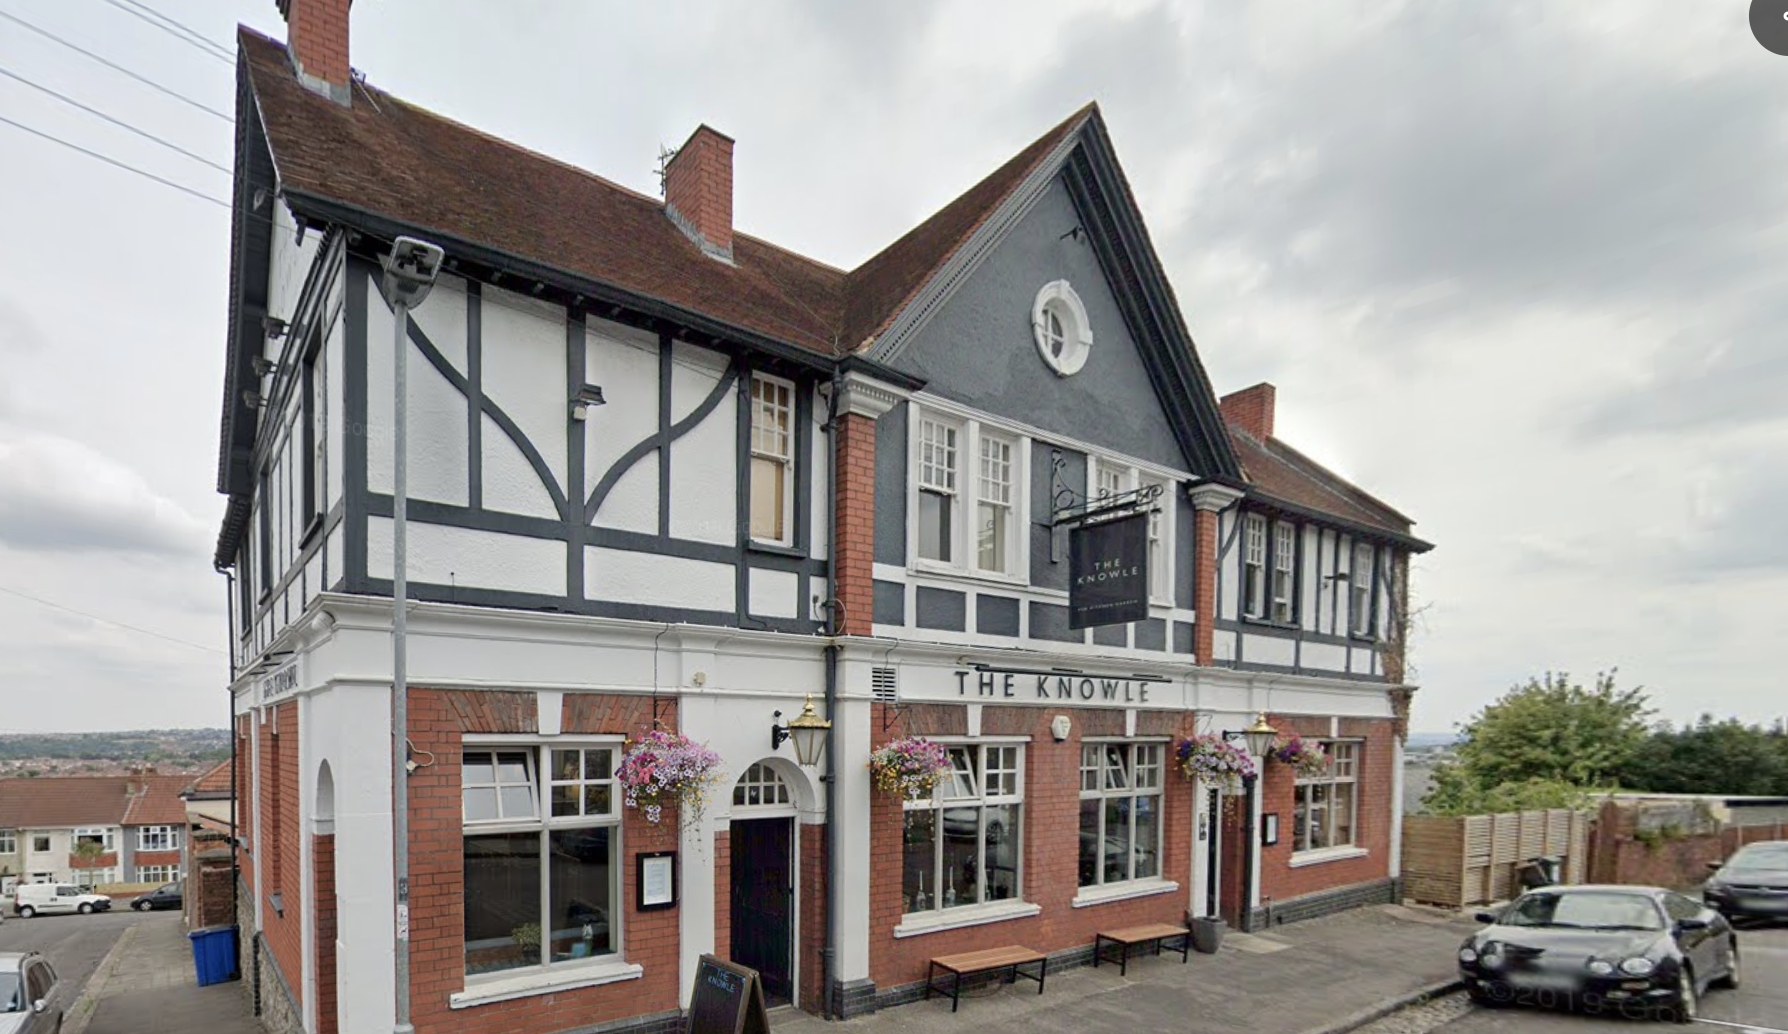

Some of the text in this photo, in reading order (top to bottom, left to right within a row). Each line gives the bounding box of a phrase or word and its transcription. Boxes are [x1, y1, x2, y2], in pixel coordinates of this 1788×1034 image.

[1094, 558, 1120, 571] THE
[1077, 566, 1139, 585] KNOWLE
[954, 671, 1149, 702] THE KNOWLE
[716, 967, 729, 980] THE
[708, 976, 735, 993] KNOWLE
